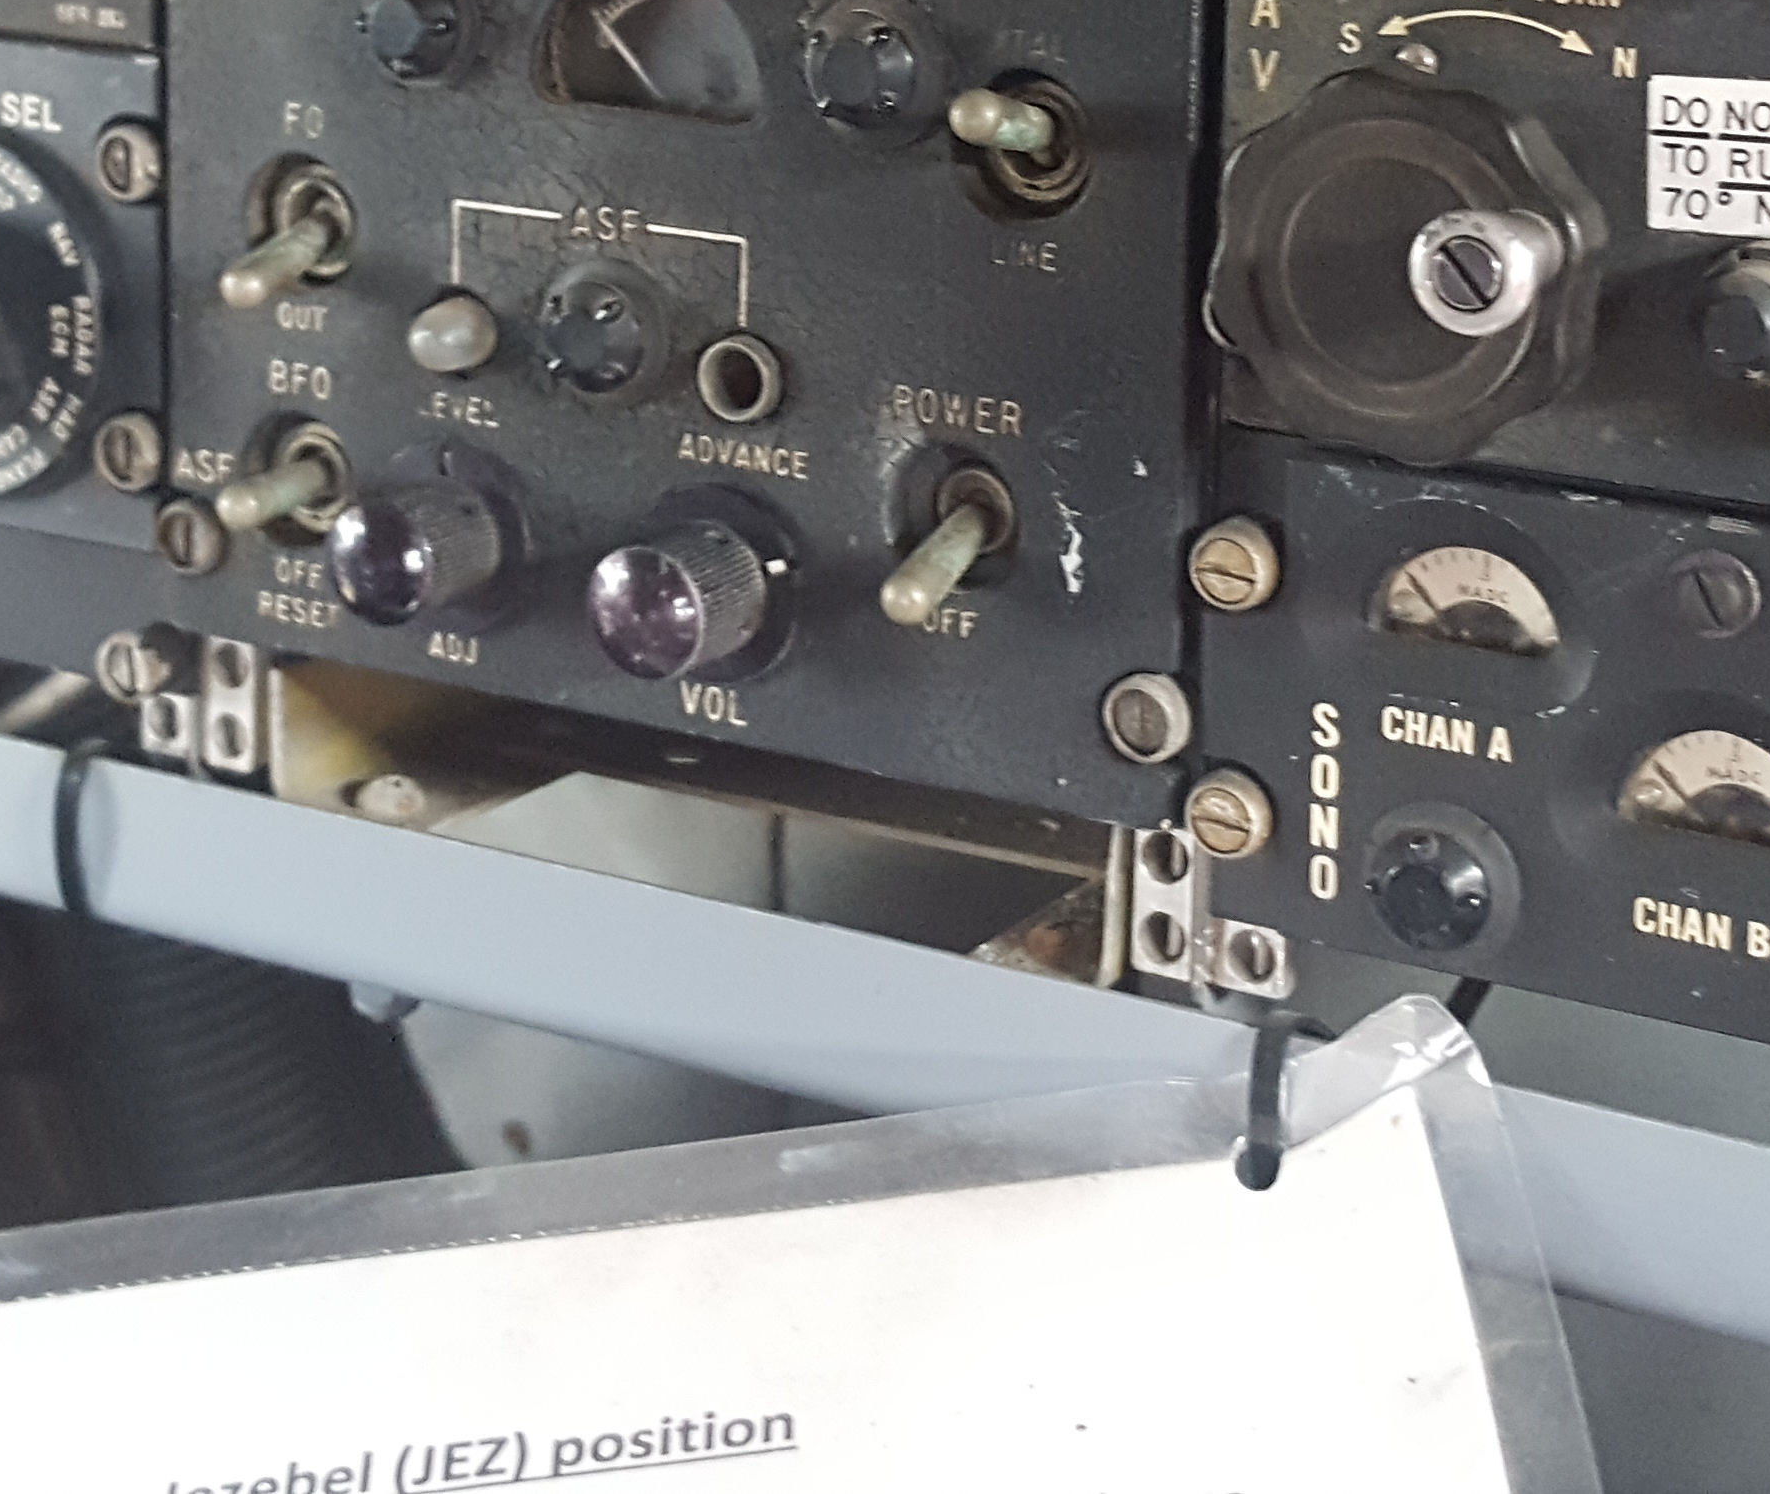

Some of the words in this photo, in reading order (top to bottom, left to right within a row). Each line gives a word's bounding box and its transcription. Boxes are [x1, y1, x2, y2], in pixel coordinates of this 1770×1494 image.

[1338, 22, 1363, 56] S
[1613, 45, 1638, 79] N
[0, 93, 62, 133] SEL
[1658, 94, 1711, 129] DO
[1662, 142, 1710, 177] TO
[276, 302, 328, 334] OUT
[890, 385, 1024, 436] POWER
[678, 432, 810, 480] ADVANCE
[274, 557, 326, 587] OFF
[258, 590, 340, 629] RESET
[923, 605, 979, 641] OFF
[428, 632, 479, 668] ADJ
[678, 681, 750, 728] VOL
[1380, 705, 1477, 757] CHAN
[1487, 727, 1514, 763] A
[1309, 701, 1341, 901] SONO
[1632, 896, 1733, 951] CHAN
[395, 1431, 528, 1494] (JEZ)
[551, 1410, 796, 1478] position
